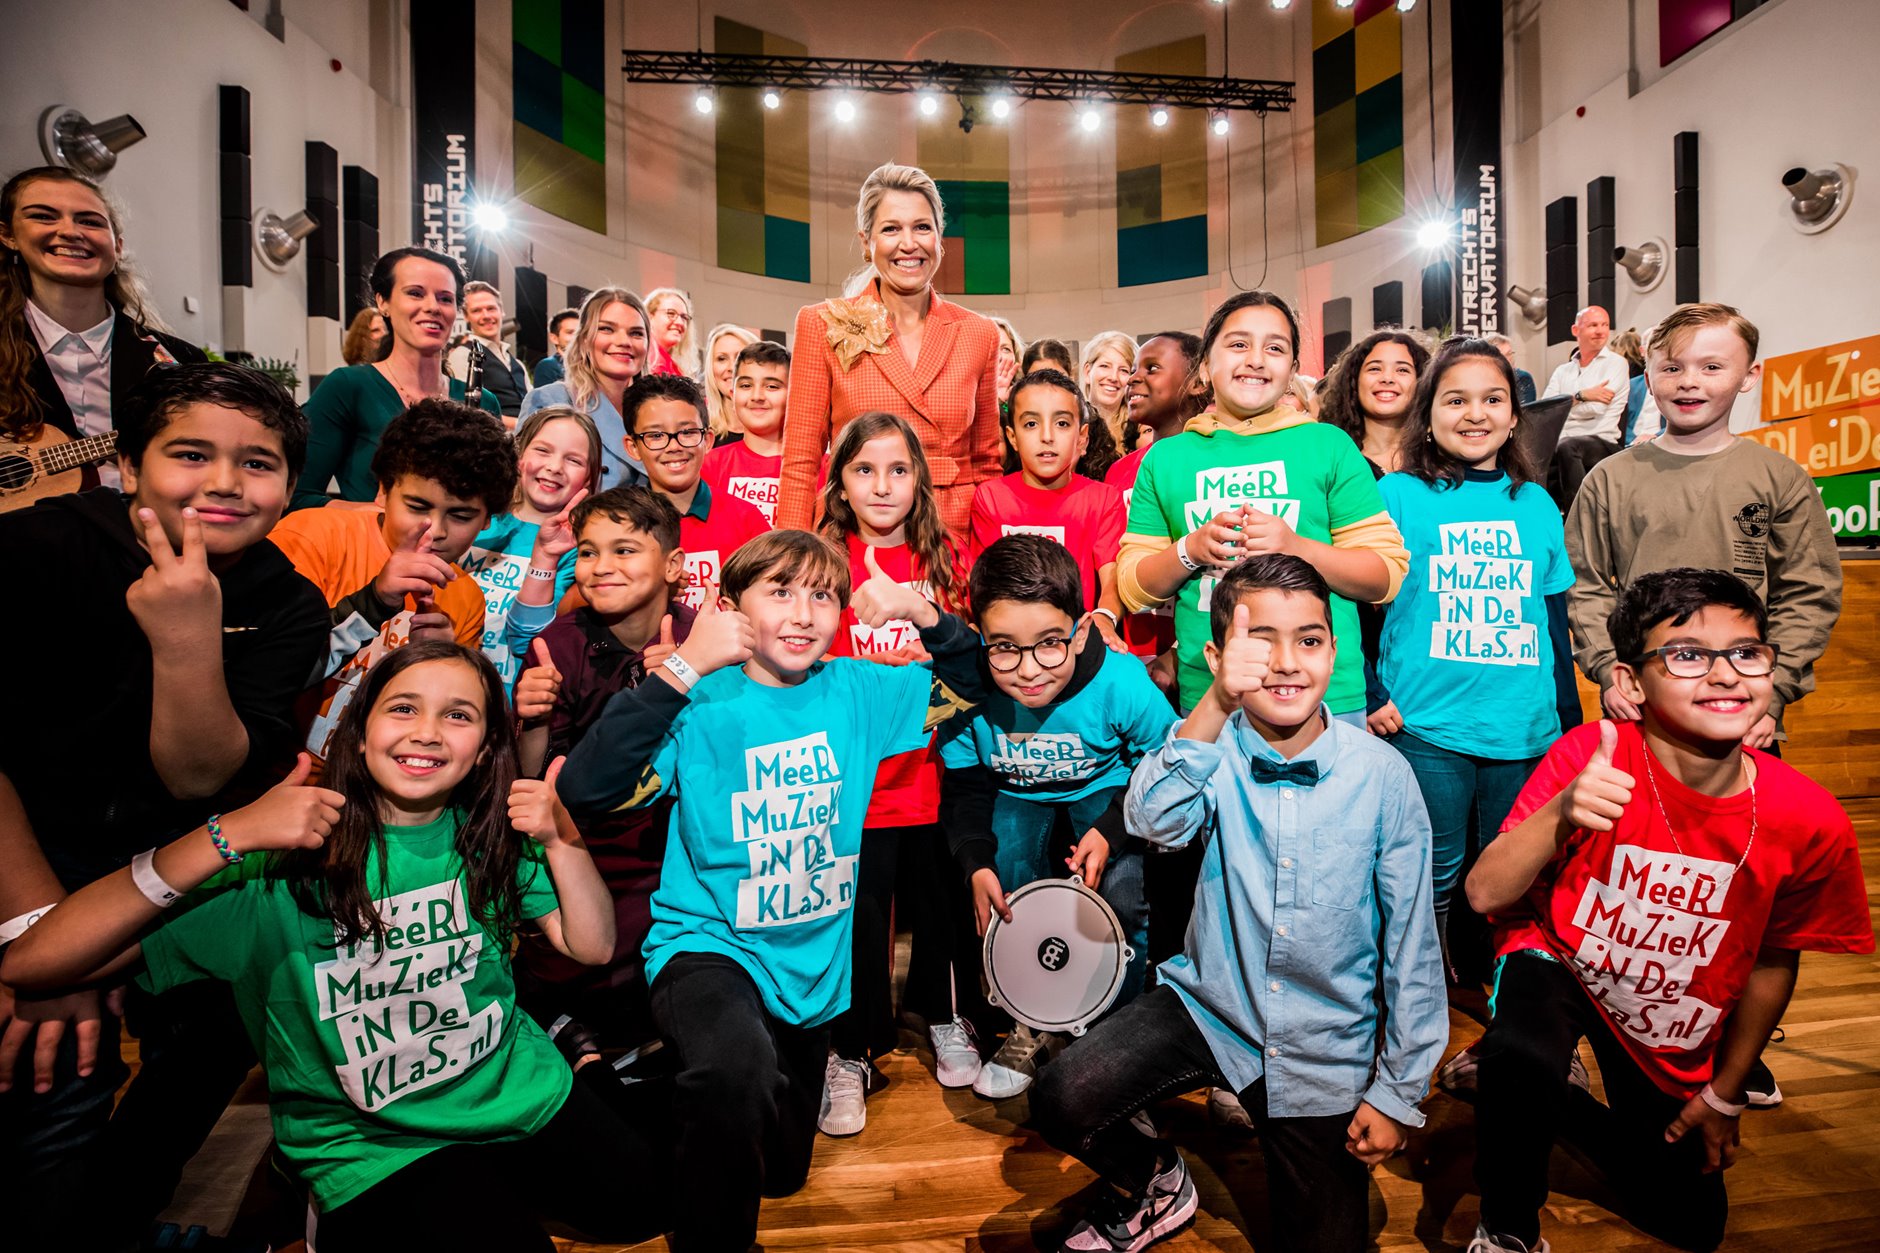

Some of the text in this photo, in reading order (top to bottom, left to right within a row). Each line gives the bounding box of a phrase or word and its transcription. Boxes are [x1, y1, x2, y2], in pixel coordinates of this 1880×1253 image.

[1462, 208, 1478, 340] UTRECHTS
[1744, 414, 1880, 472] PLeiD
[733, 482, 779, 503] MééR
[1203, 470, 1277, 500] MééR
[1817, 480, 1880, 534] oo
[1448, 528, 1513, 556] MééR
[462, 550, 521, 587] MééR
[1437, 562, 1525, 590] MuZieK
[1448, 595, 1516, 624] iN De
[755, 744, 834, 791] MééR
[998, 760, 1089, 779] MuZieK
[1005, 737, 1081, 761] MééR
[740, 785, 842, 839] MuZieK
[759, 834, 827, 877] iN De
[1618, 853, 1717, 913] MééR
[1585, 891, 1719, 958] MuZieK
[327, 940, 472, 1014] MuZieK
[1584, 944, 1680, 999] iN De
[351, 1000, 459, 1058] iN De
